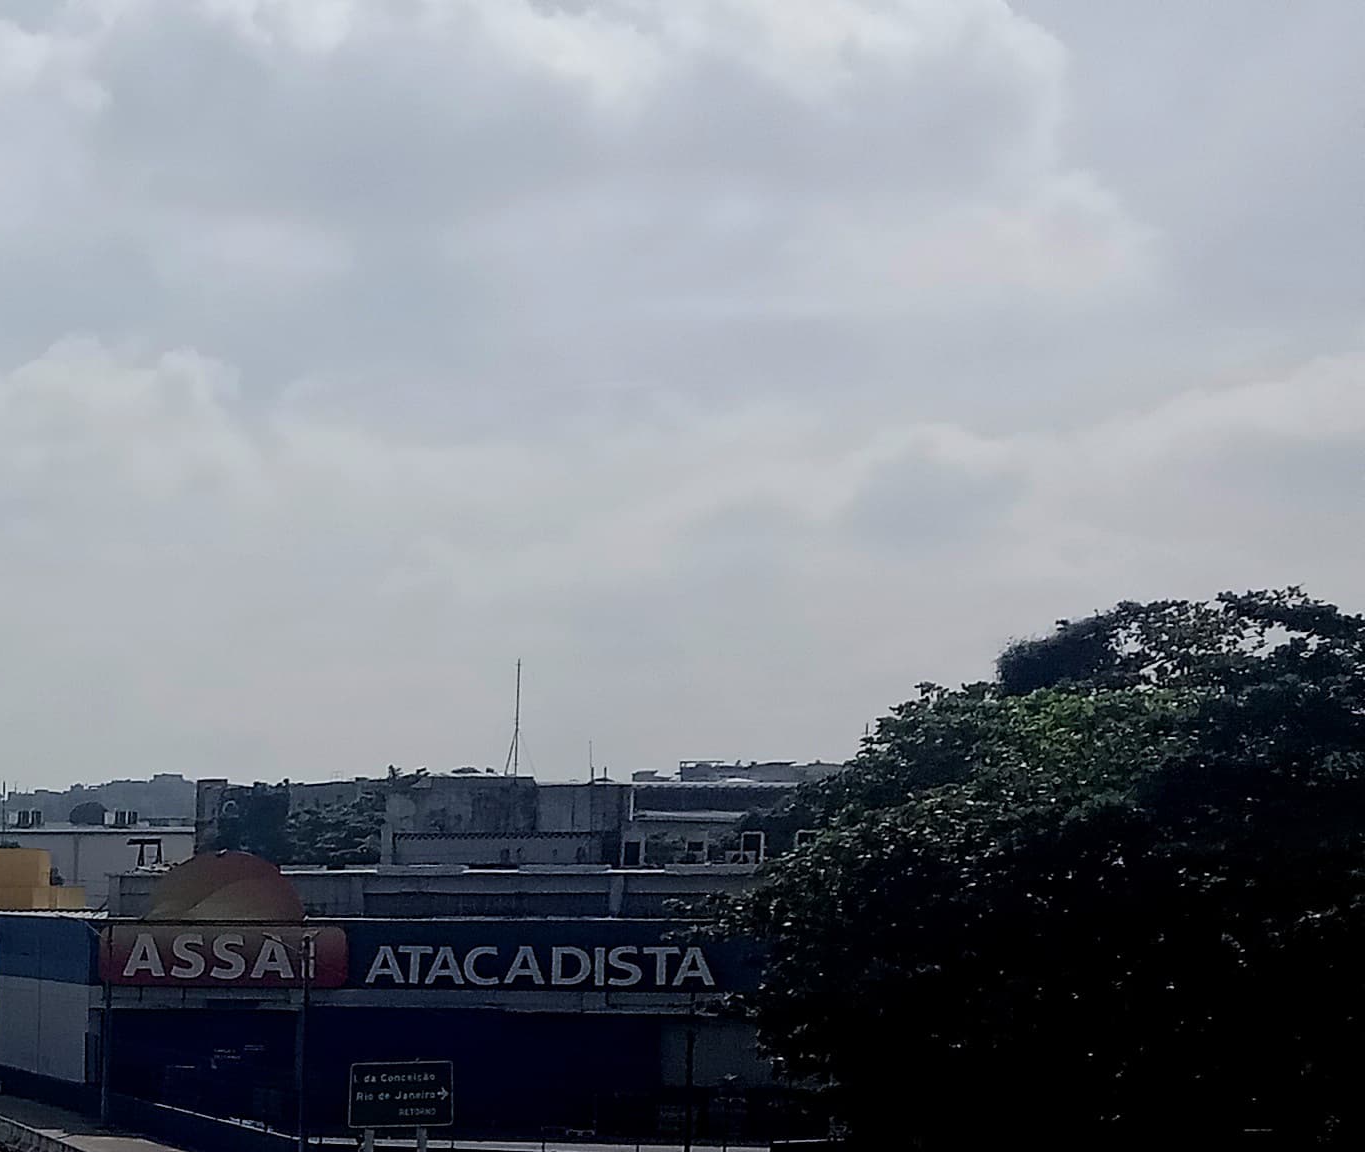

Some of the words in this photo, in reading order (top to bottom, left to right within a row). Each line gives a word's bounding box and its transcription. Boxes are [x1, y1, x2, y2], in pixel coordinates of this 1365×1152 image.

[365, 945, 716, 987] ATACADISTA
[356, 1091, 374, 1102] Rio
[378, 1091, 391, 1101] de
[394, 1090, 436, 1101] Janeiro
